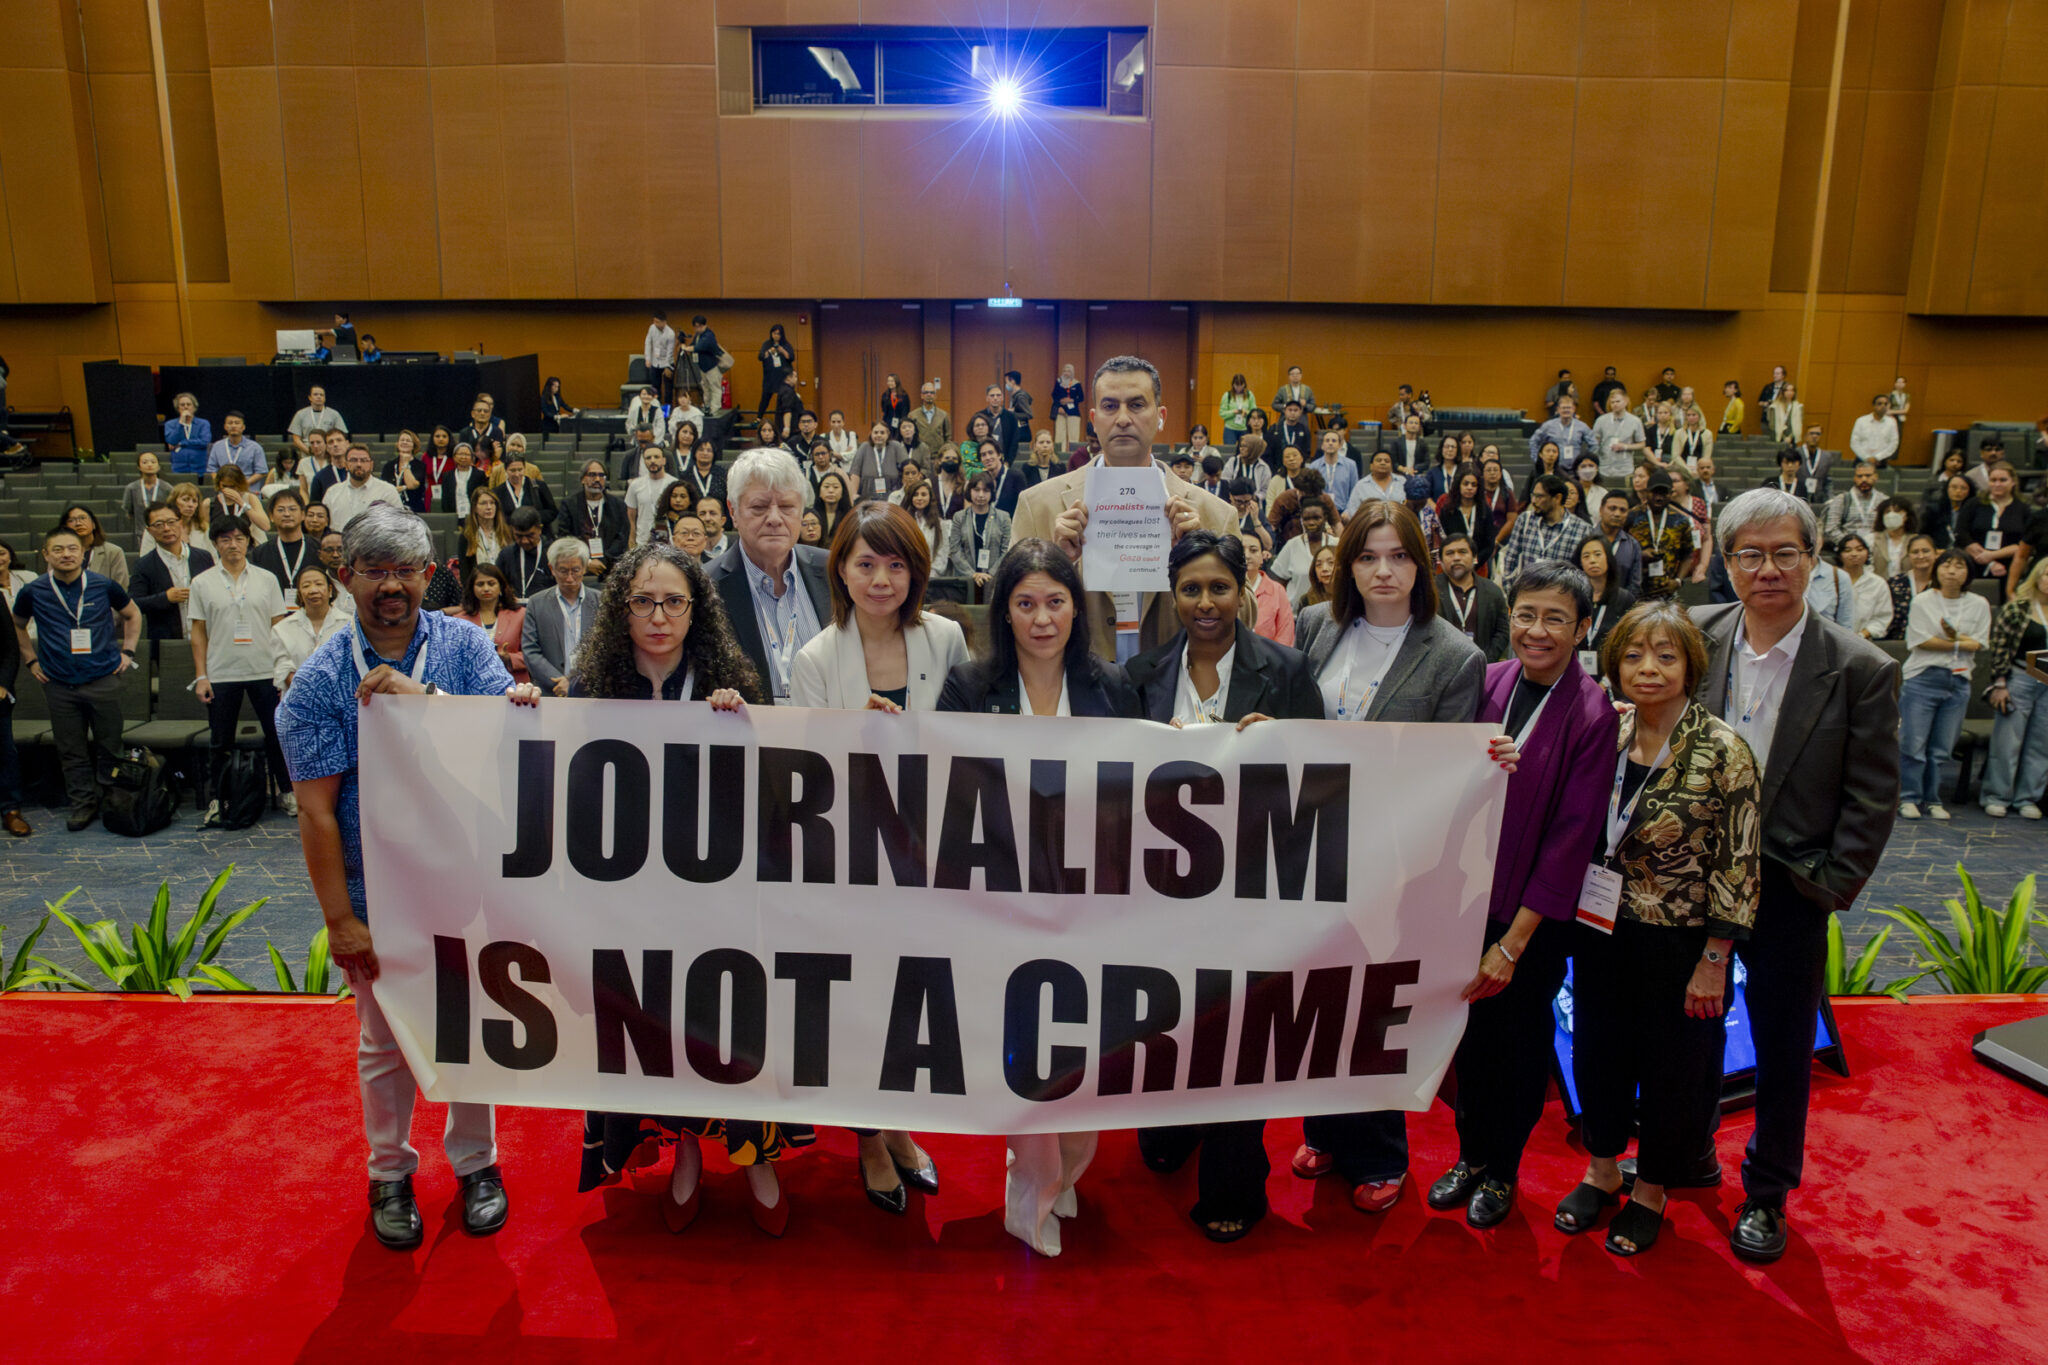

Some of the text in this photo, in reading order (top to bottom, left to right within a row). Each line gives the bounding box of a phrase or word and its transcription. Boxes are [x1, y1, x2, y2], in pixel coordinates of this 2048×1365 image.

[1095, 504, 1144, 512] journalists
[1097, 530, 1116, 538] their
[1120, 554, 1141, 562] Gaza
[502, 738, 1351, 903] JOURNALISM
[433, 935, 1421, 1103] IS NOT A CRIME
